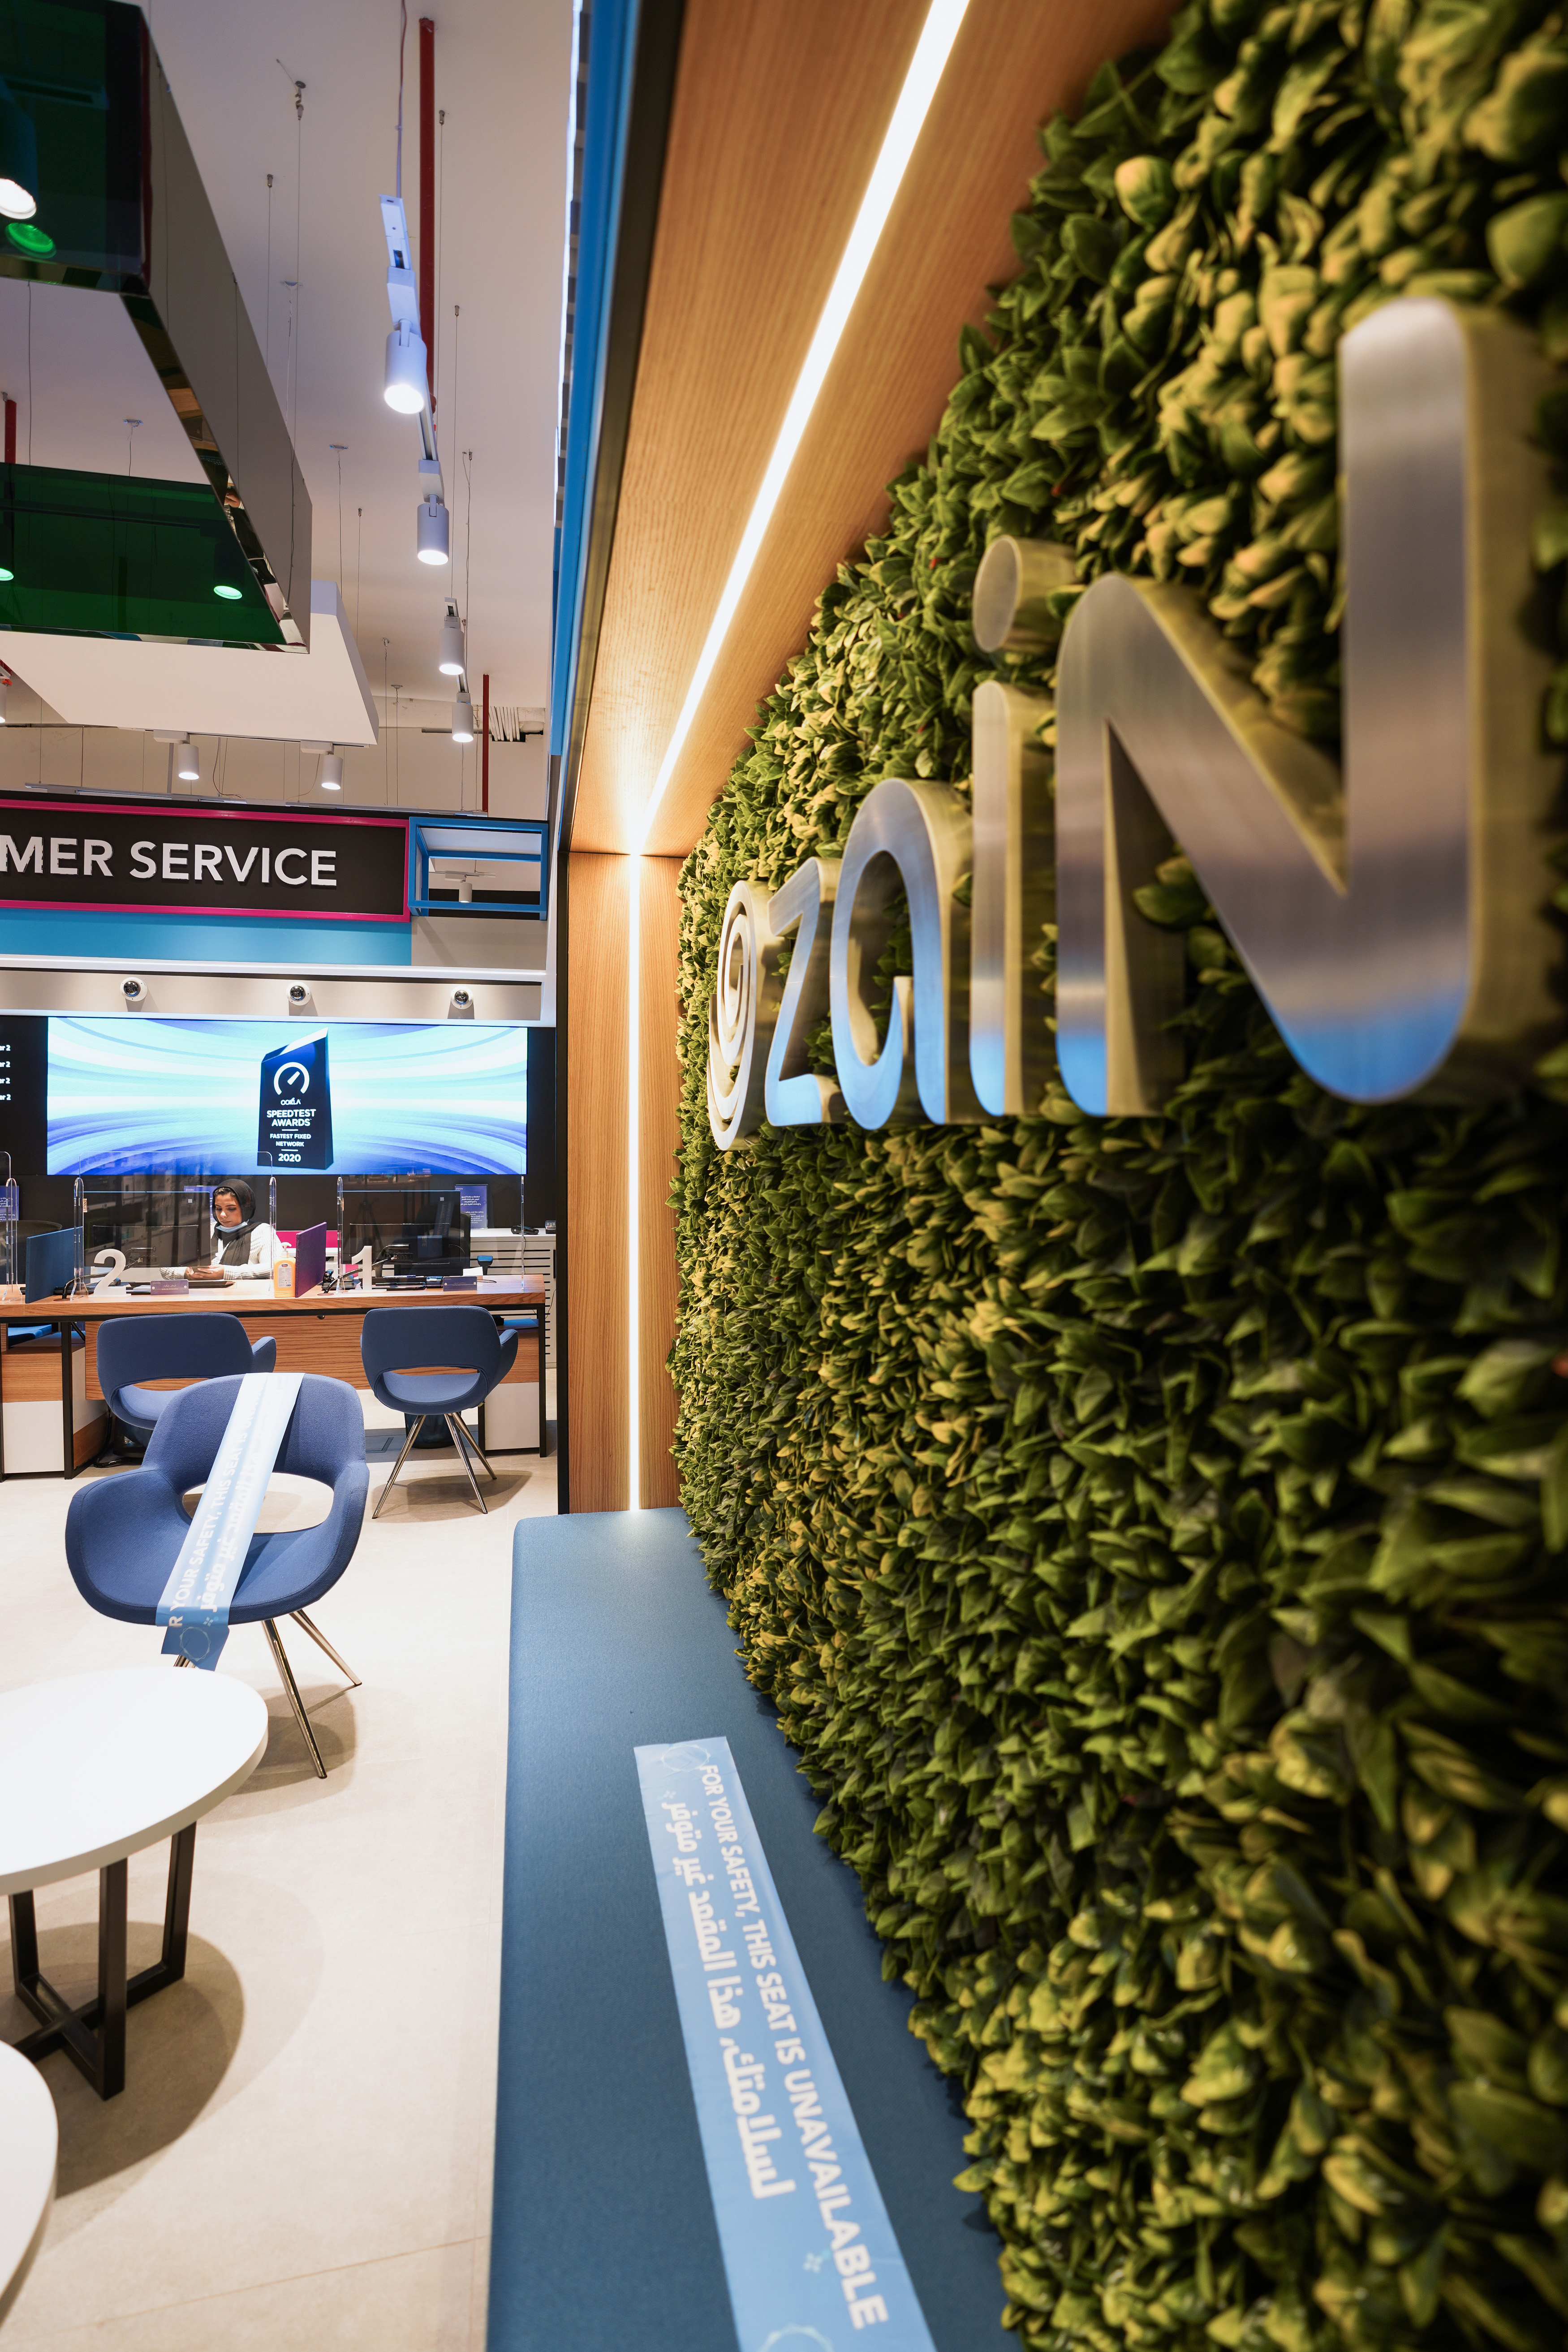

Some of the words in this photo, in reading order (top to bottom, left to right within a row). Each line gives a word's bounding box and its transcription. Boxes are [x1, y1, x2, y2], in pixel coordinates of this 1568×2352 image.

[129, 841, 337, 887] SERVICE
[267, 1109, 316, 1118] SPEEDTEST
[271, 1118, 311, 1126] AWARDS
[280, 1097, 301, 1105] OOKLA
[278, 1154, 301, 1162] 2020
[94, 1249, 126, 1296] 2
[352, 1246, 372, 1290] 1
[170, 1568, 200, 1611] YOUR
[211, 1480, 232, 1509] THIS
[224, 1447, 243, 1476] SEAT
[196, 1564, 226, 1612] متوفر
[699, 1764, 724, 1796] FOR
[661, 1801, 702, 1853] متوفر
[709, 1796, 738, 1844] YOUR
[672, 1857, 714, 1886] غير
[721, 1844, 761, 1917] SAFETY,
[688, 1890, 737, 1971] المقعد
[742, 1918, 776, 1969] THIS
[706, 1975, 744, 2029] هذا
[756, 1972, 797, 2032] SEAT
[775, 2037, 806, 2065] IS
[784, 2068, 889, 2330] UNAVAILABLE
